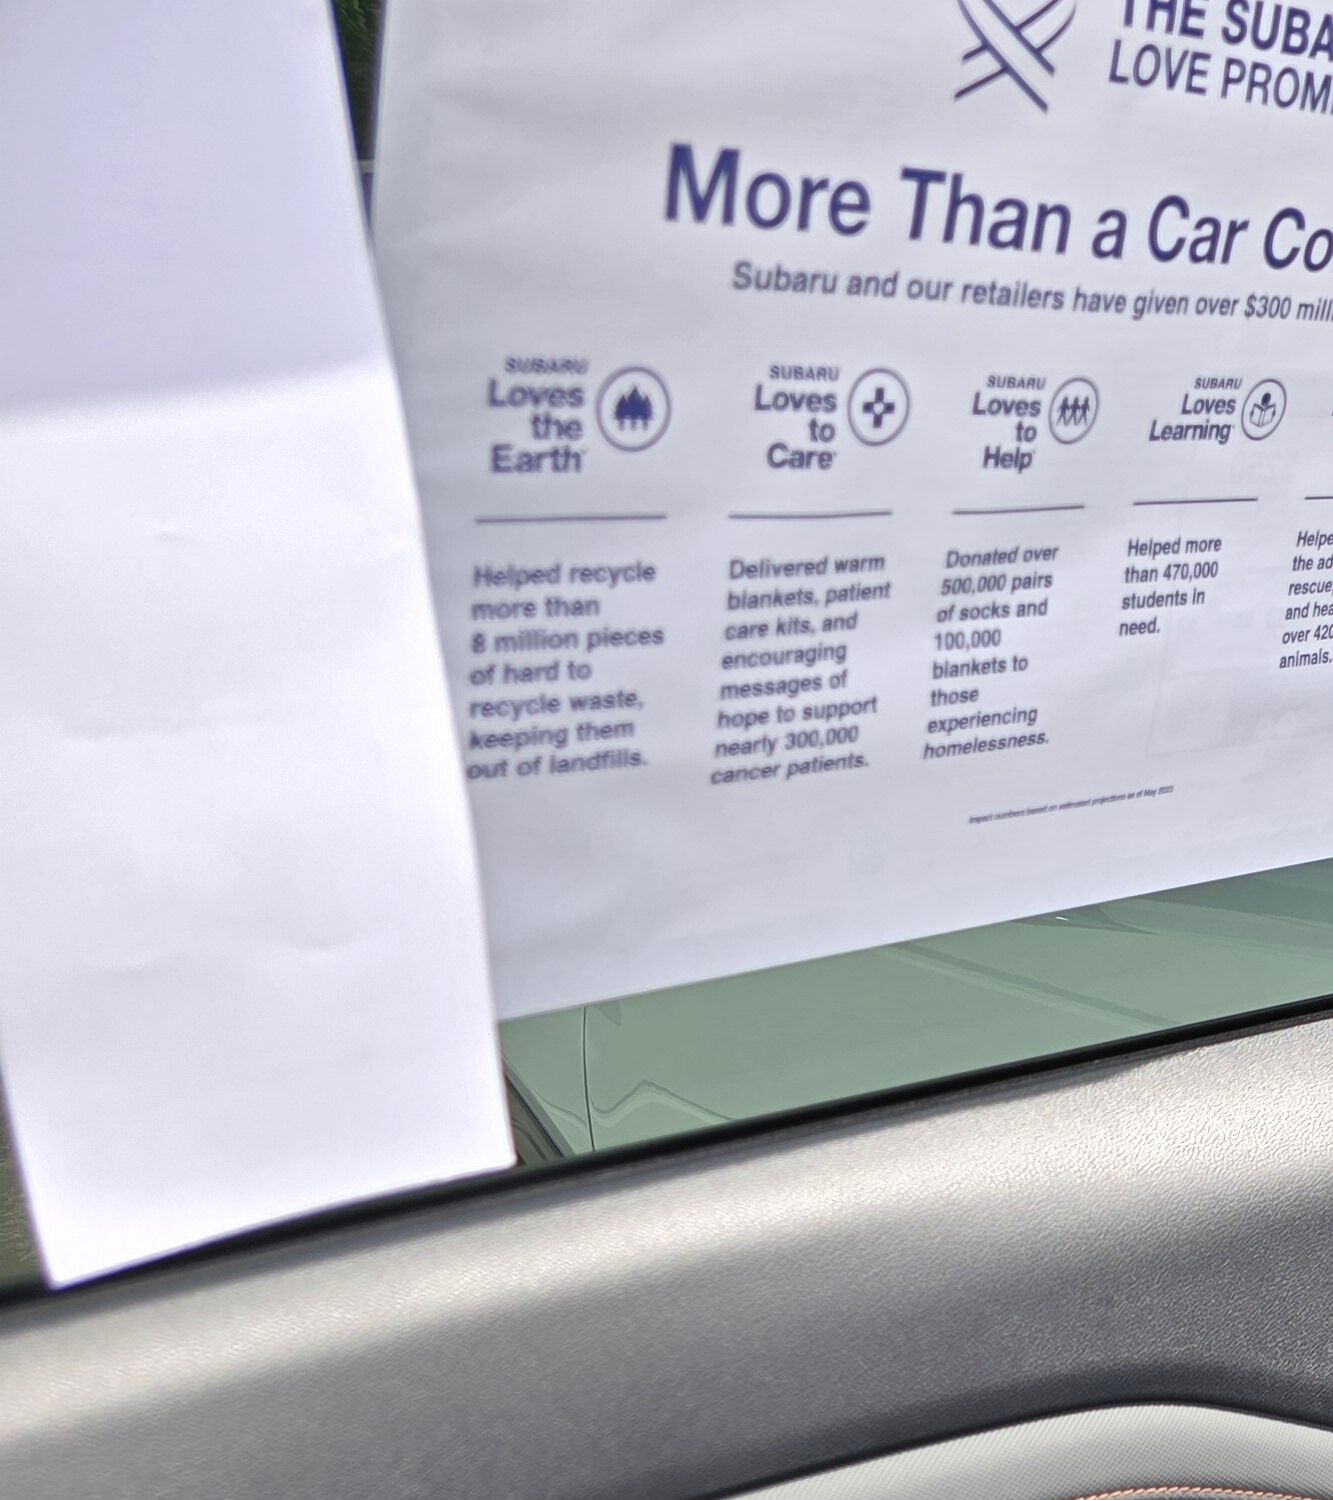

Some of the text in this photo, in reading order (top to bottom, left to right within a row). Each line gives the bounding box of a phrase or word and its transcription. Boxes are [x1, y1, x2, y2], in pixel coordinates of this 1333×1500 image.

[1108, 38, 1212, 96] LOVE
[664, 141, 872, 237] More
[899, 165, 1072, 255] Than
[1091, 208, 1128, 261] a
[1148, 194, 1249, 265] Car
[732, 260, 838, 295] Subaru
[846, 271, 900, 299] and
[906, 280, 954, 302] our
[961, 281, 1066, 312] retailers
[1073, 286, 1127, 315] have
[1133, 290, 1189, 321] given
[1195, 298, 1239, 318] over
[1244, 292, 1292, 320] $300
[504, 355, 590, 375] SUBARU
[769, 364, 840, 382] SUBARU
[487, 376, 586, 409] Loves
[986, 374, 1047, 391] SUBARU
[1193, 376, 1243, 392] SUBARU
[754, 383, 838, 413] Loves
[971, 391, 1042, 417] Loves
[1180, 392, 1237, 416] Loves
[531, 412, 584, 442] the
[808, 417, 836, 443] to
[1014, 421, 1038, 444] to
[1149, 418, 1232, 445] Learning
[489, 442, 583, 474] Earth
[767, 441, 834, 470] Care
[982, 445, 1034, 474] Help
[945, 545, 1060, 569] Donated over
[1127, 536, 1222, 560] Helped more
[473, 559, 657, 591] Helped recycle
[729, 555, 885, 580] Delivered warm
[1124, 560, 1219, 584] than 470,000
[1292, 554, 1314, 573] the
[727, 580, 891, 611] blankets, patient
[940, 571, 1054, 597] 500,000 pairs
[471, 596, 601, 621] more than
[936, 597, 1049, 623] of socks and
[1121, 587, 1206, 610] students in
[1284, 602, 1310, 621] and
[724, 611, 859, 641] care kits, and
[1118, 616, 1161, 637] need.
[1281, 629, 1311, 645] over
[471, 626, 666, 654] 8 million pieces
[934, 628, 1003, 651] 100,000
[721, 642, 847, 670] encouraging
[932, 654, 1029, 680] blankets to
[1278, 648, 1333, 669] animals.
[469, 660, 592, 686] of hard to
[720, 668, 848, 701] messages of
[469, 689, 645, 721] recycle waste,
[930, 688, 980, 707] those
[717, 696, 878, 731] hope to support
[927, 706, 1039, 736] experiencing
[469, 721, 635, 751] keeping them
[714, 724, 860, 758] nearly 300,000
[922, 730, 1050, 760] homelessness.
[466, 749, 648, 780] out of landfills.
[710, 752, 869, 786] cancer patients.
